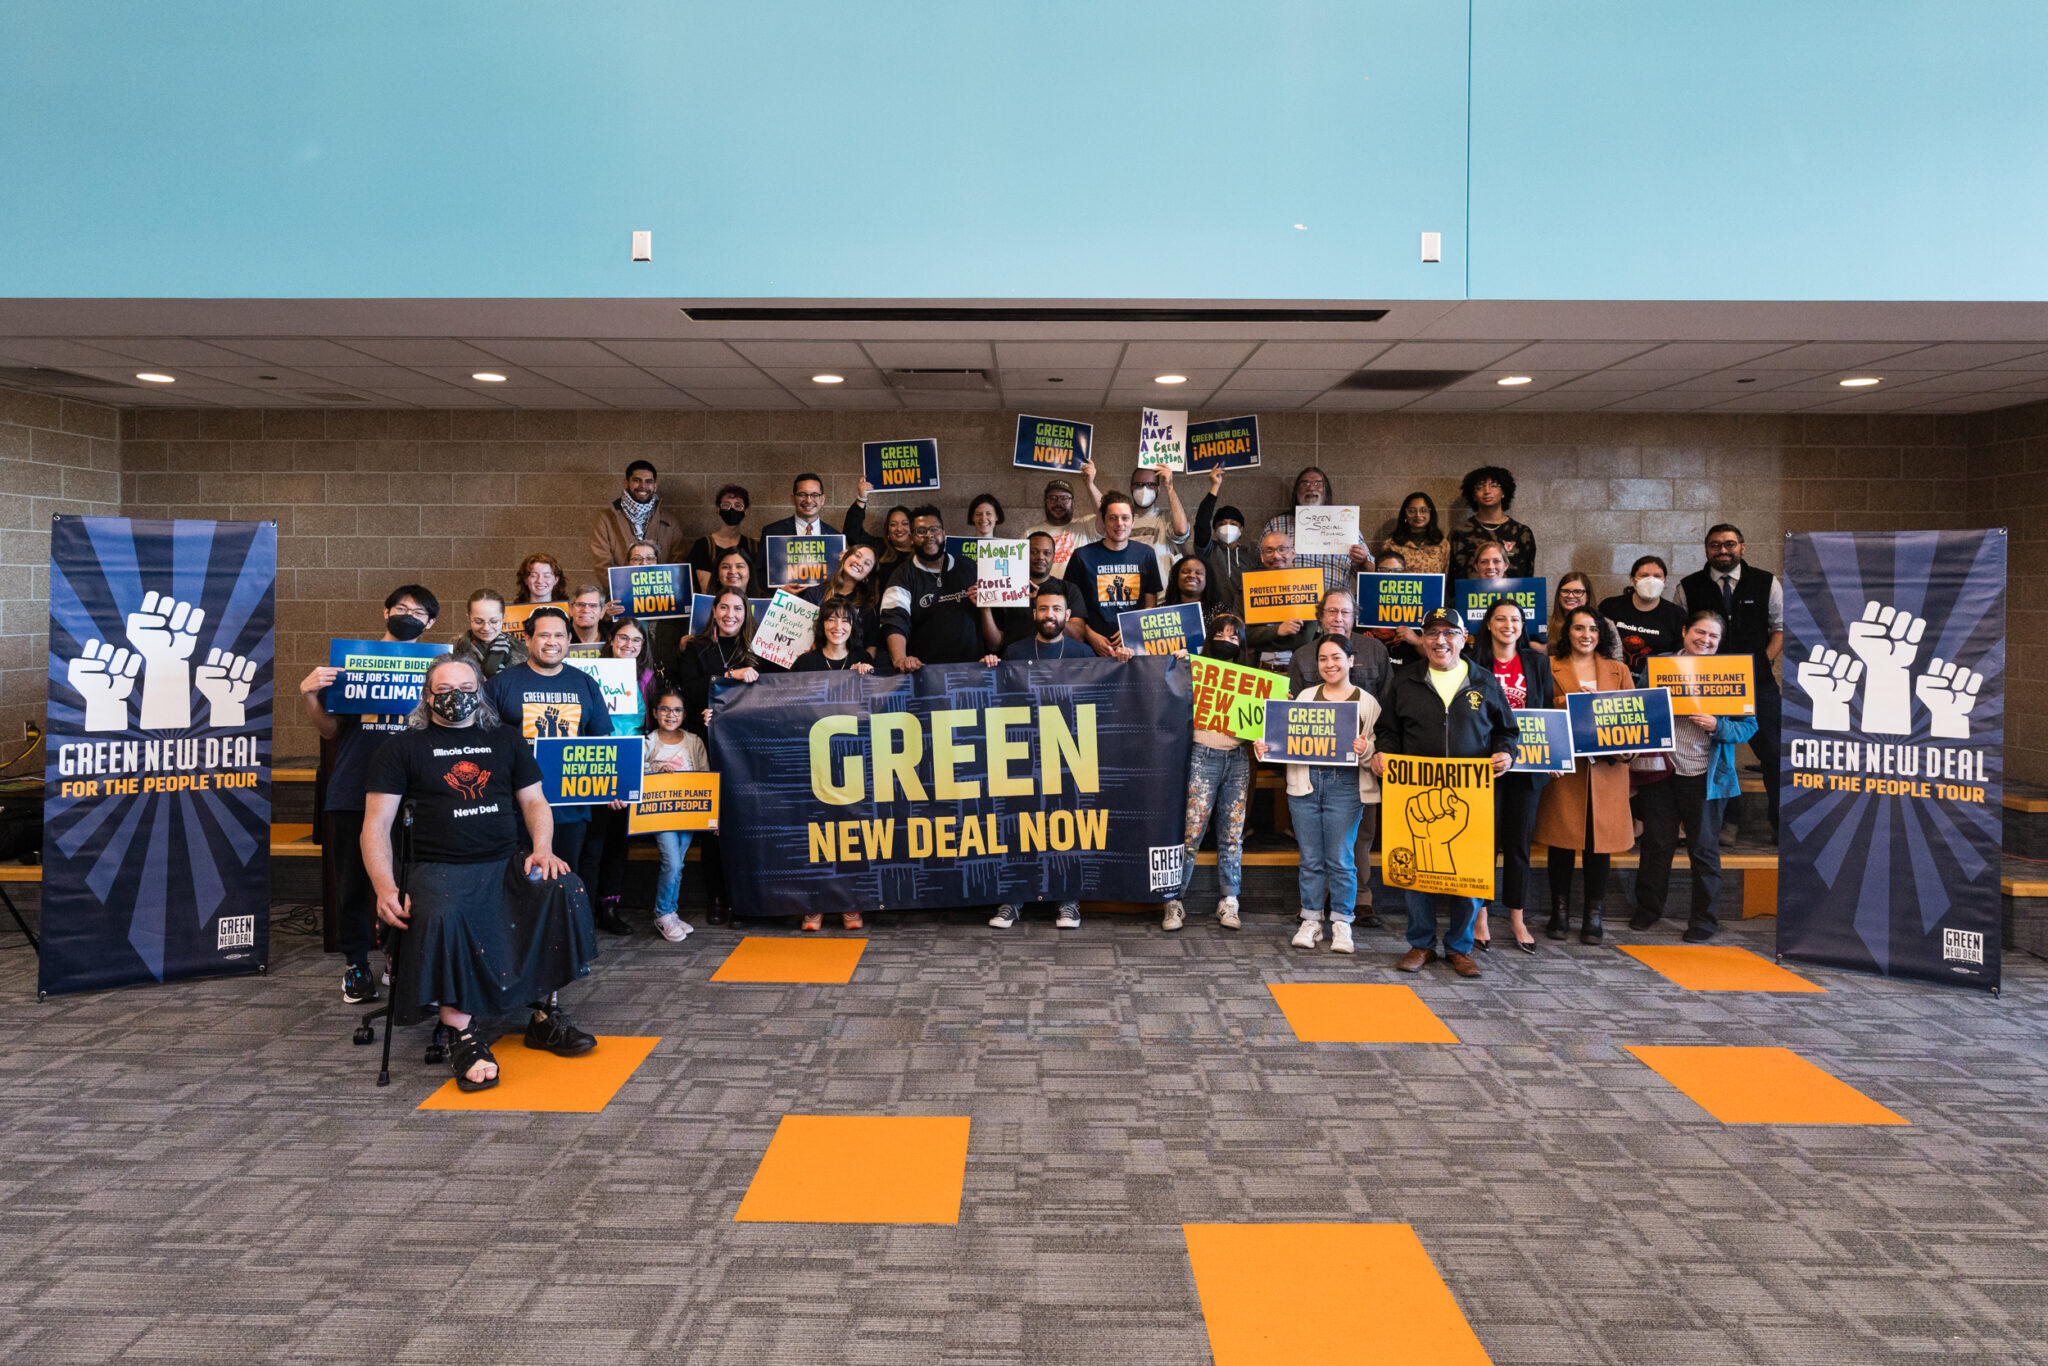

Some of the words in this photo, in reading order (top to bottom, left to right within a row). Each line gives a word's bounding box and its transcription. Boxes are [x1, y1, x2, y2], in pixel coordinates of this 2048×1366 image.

[1144, 411, 1159, 427] WE
[1036, 423, 1074, 439] GREEN
[1142, 425, 1173, 440] HAVE
[1191, 433, 1214, 443] GREEN
[1215, 430, 1230, 440] NEW
[1232, 428, 1251, 438] DEAL
[1035, 436, 1053, 447] NEW
[1054, 438, 1073, 449] DEAL
[1141, 440, 1149, 452] A
[1193, 437, 1251, 461] ¡AHORA!
[881, 445, 918, 460] GREEN
[1033, 445, 1073, 466] NOW!
[882, 460, 899, 469] NEW
[901, 459, 920, 468] DEAL
[882, 468, 921, 485] NOW!
[787, 541, 825, 554] GREEN
[979, 542, 1027, 560] MONEY
[787, 554, 806, 564] NEW
[806, 554, 827, 563] DEAL
[787, 564, 827, 580] NOW!
[995, 559, 1009, 576] 4
[631, 571, 672, 585] GREEN
[632, 586, 651, 596] NEW
[653, 585, 674, 595] DEAL
[1249, 586, 1277, 595] PROTECT
[1278, 585, 1291, 593] THE
[1292, 584, 1318, 592] PLANET
[1379, 580, 1422, 594] GREEN
[633, 594, 676, 613] NOW!
[773, 591, 818, 620] Invest
[1253, 596, 1270, 606] AND
[1271, 595, 1284, 605] ITS
[1285, 594, 1315, 604] PEOPLE
[1379, 594, 1399, 604] NEW
[1401, 595, 1423, 605] DEAL
[1140, 612, 1182, 629] GREEN
[1378, 605, 1423, 623] NOW!
[774, 632, 795, 646] NOT
[1142, 629, 1162, 640] NEW
[1163, 626, 1184, 637] DEAL
[1144, 636, 1187, 655] NOW!
[349, 658, 402, 669] PRESIDENT
[346, 672, 365, 682] THE
[365, 672, 390, 683] JOB'S
[392, 674, 410, 683] NOT
[1191, 660, 1273, 700] GREEN
[1657, 674, 1692, 683] PROTECT
[1695, 674, 1710, 682] THE
[1713, 673, 1745, 682] PLANET
[344, 684, 368, 699] ON
[523, 692, 545, 703] GREEN
[546, 692, 561, 703] NEW
[562, 693, 580, 704] DEAL
[1685, 685, 1701, 696] ITS
[1703, 685, 1742, 696] PEOPLE
[1592, 696, 1645, 714] GREEN
[1194, 707, 1236, 737] EAL
[1238, 703, 1264, 730] NO
[1288, 707, 1336, 724] GREEN
[1594, 715, 1618, 726] NEW
[1620, 713, 1648, 725] DEAL
[1288, 724, 1310, 735] NEW
[1312, 725, 1336, 736] DEAL
[1596, 724, 1650, 747] NOW!
[1287, 735, 1336, 757] NOW!
[1522, 733, 1549, 744] DEAL
[59, 740, 138, 775] GREEN
[145, 738, 198, 771] NEW
[205, 736, 261, 768] DEAL
[433, 747, 463, 757] Illinois
[463, 746, 492, 755] Green
[562, 745, 617, 762] GREEN
[809, 703, 1100, 806] GREEN
[1790, 739, 1860, 771] GREEN
[1866, 743, 1919, 776] NEW
[1926, 747, 1989, 782] DEAL
[562, 764, 588, 775] NEW
[590, 763, 618, 775] DEAL
[1387, 759, 1490, 788] SOLIDARITY!
[61, 781, 98, 798] FOR
[103, 778, 139, 795] THE
[144, 774, 209, 793] PEOPLE
[214, 772, 258, 789] TOUR
[561, 776, 618, 797] NOW!
[1793, 773, 1824, 789] FOR
[1828, 775, 1861, 792] THE
[1865, 778, 1931, 798] PEOPLE
[1935, 783, 1985, 803] TOUR
[642, 790, 667, 800] ROTECT
[669, 790, 682, 798] THE
[684, 789, 712, 798] PLANET
[453, 808, 478, 818] New
[479, 804, 499, 814] Deal
[639, 802, 658, 813] AND
[659, 801, 673, 812] ITS
[674, 800, 709, 810] PEOPLE
[807, 818, 895, 863] NEW
[907, 813, 1009, 859] DEAL
[1019, 809, 1109, 853] NOW
[1152, 846, 1184, 871] GREEN
[1152, 871, 1169, 886] NEW
[221, 917, 252, 935] GREEN
[220, 934, 235, 946] NEW
[236, 934, 252, 944] DEAL
[1946, 931, 1980, 950] GREEN
[1945, 946, 1961, 957] NEW
[1962, 949, 1981, 961] DEAL
